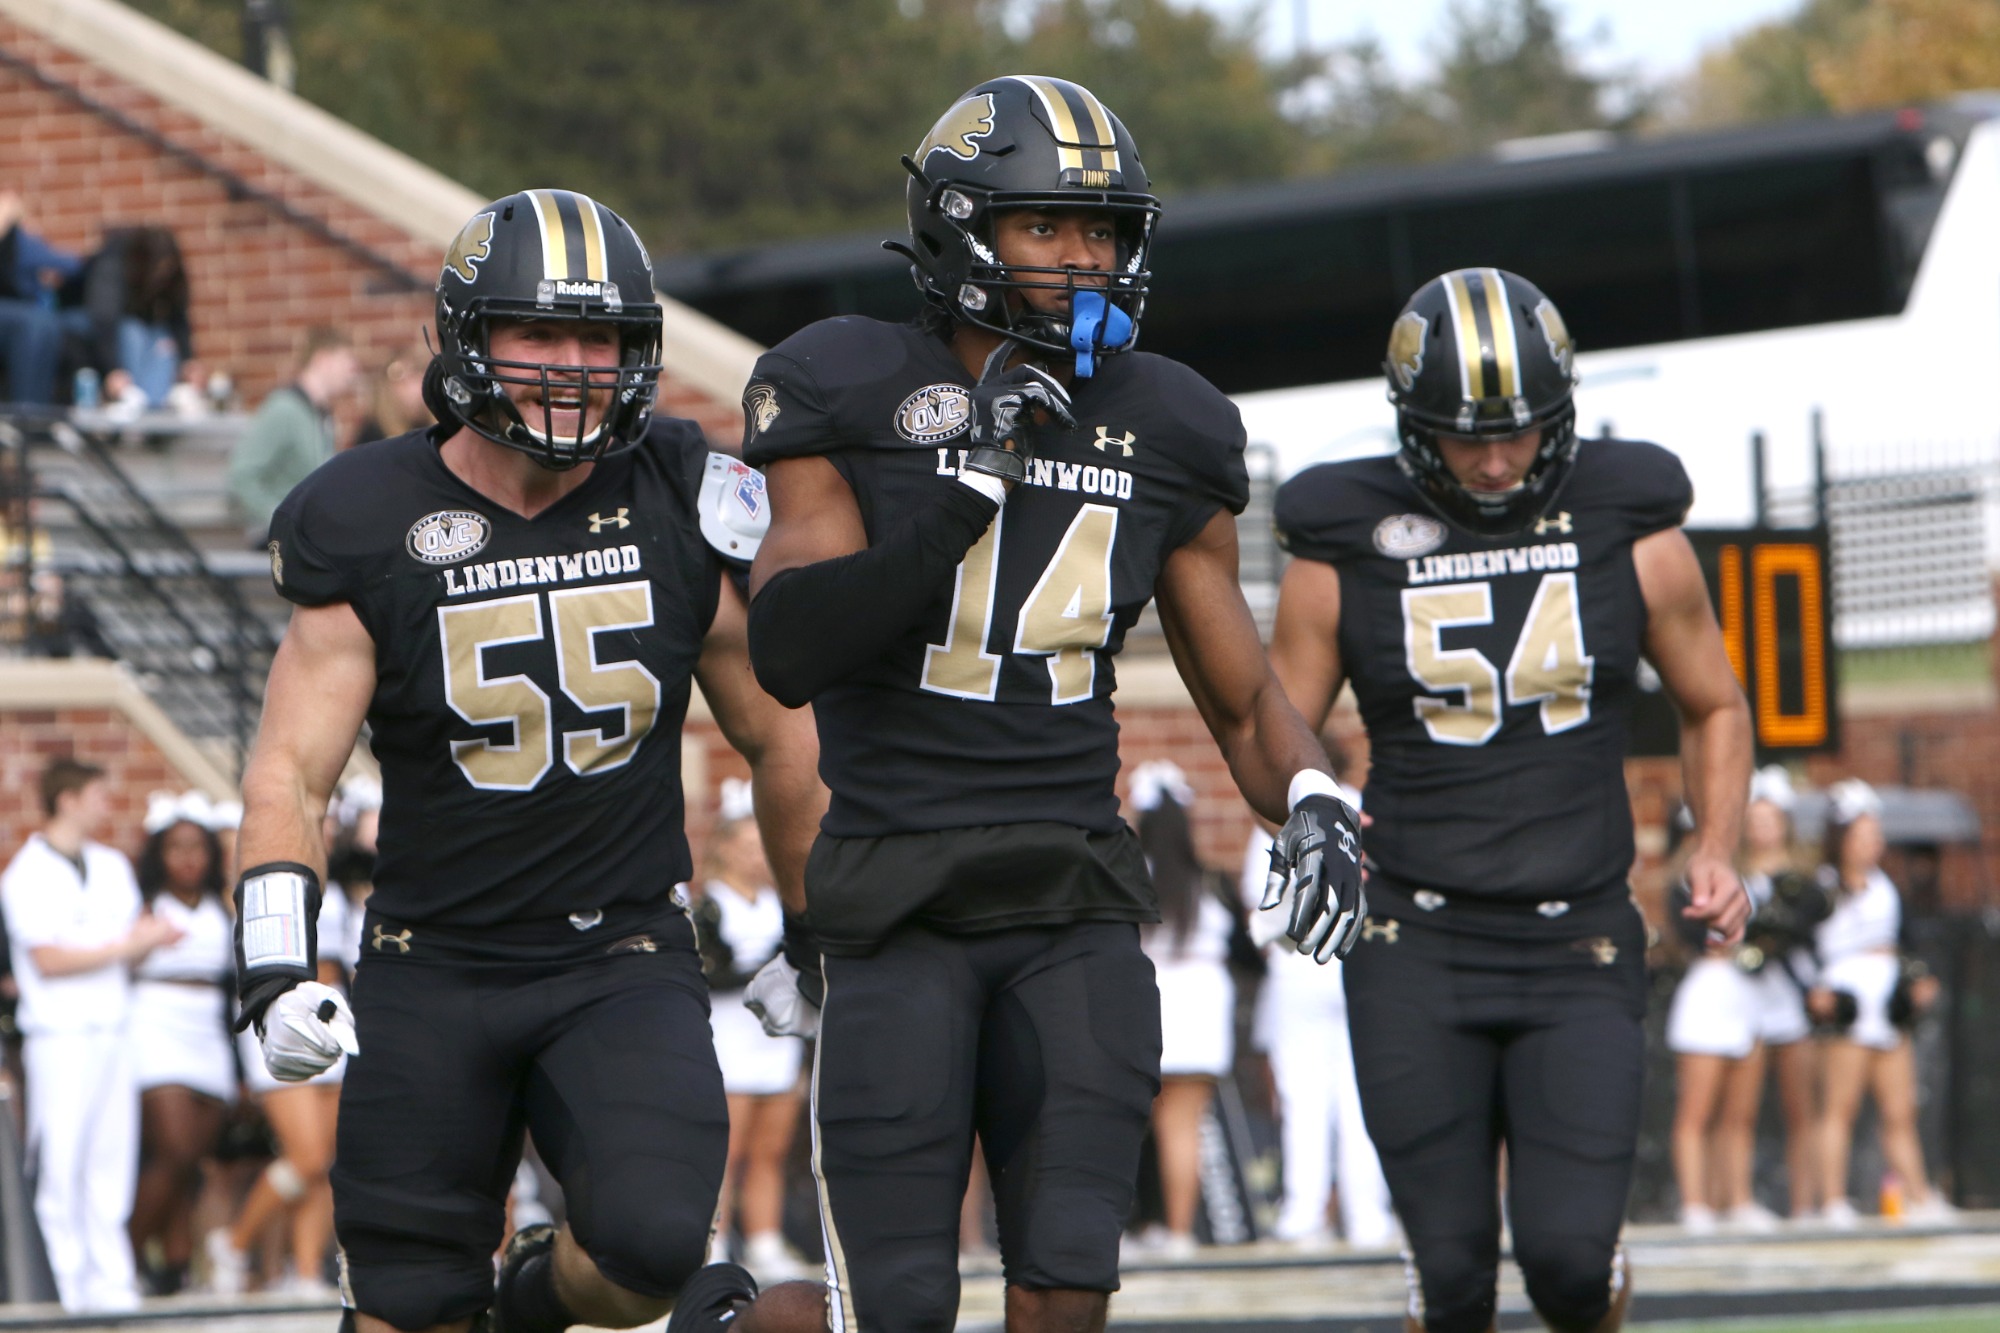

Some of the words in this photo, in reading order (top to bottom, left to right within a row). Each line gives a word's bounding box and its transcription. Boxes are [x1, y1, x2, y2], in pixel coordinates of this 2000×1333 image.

[1082, 169, 1110, 188] LIONS
[556, 280, 601, 296] Riddell
[911, 420, 969, 440] CONFERENC
[914, 396, 961, 432] OVC
[936, 448, 1133, 500] LINWOOD
[424, 521, 472, 553] OVC
[444, 544, 641, 596] LINDENWOOD
[1406, 542, 1580, 585] LINDENWOOD
[919, 502, 1118, 706] 14
[1401, 571, 1595, 747] 54
[437, 580, 661, 791] 55
